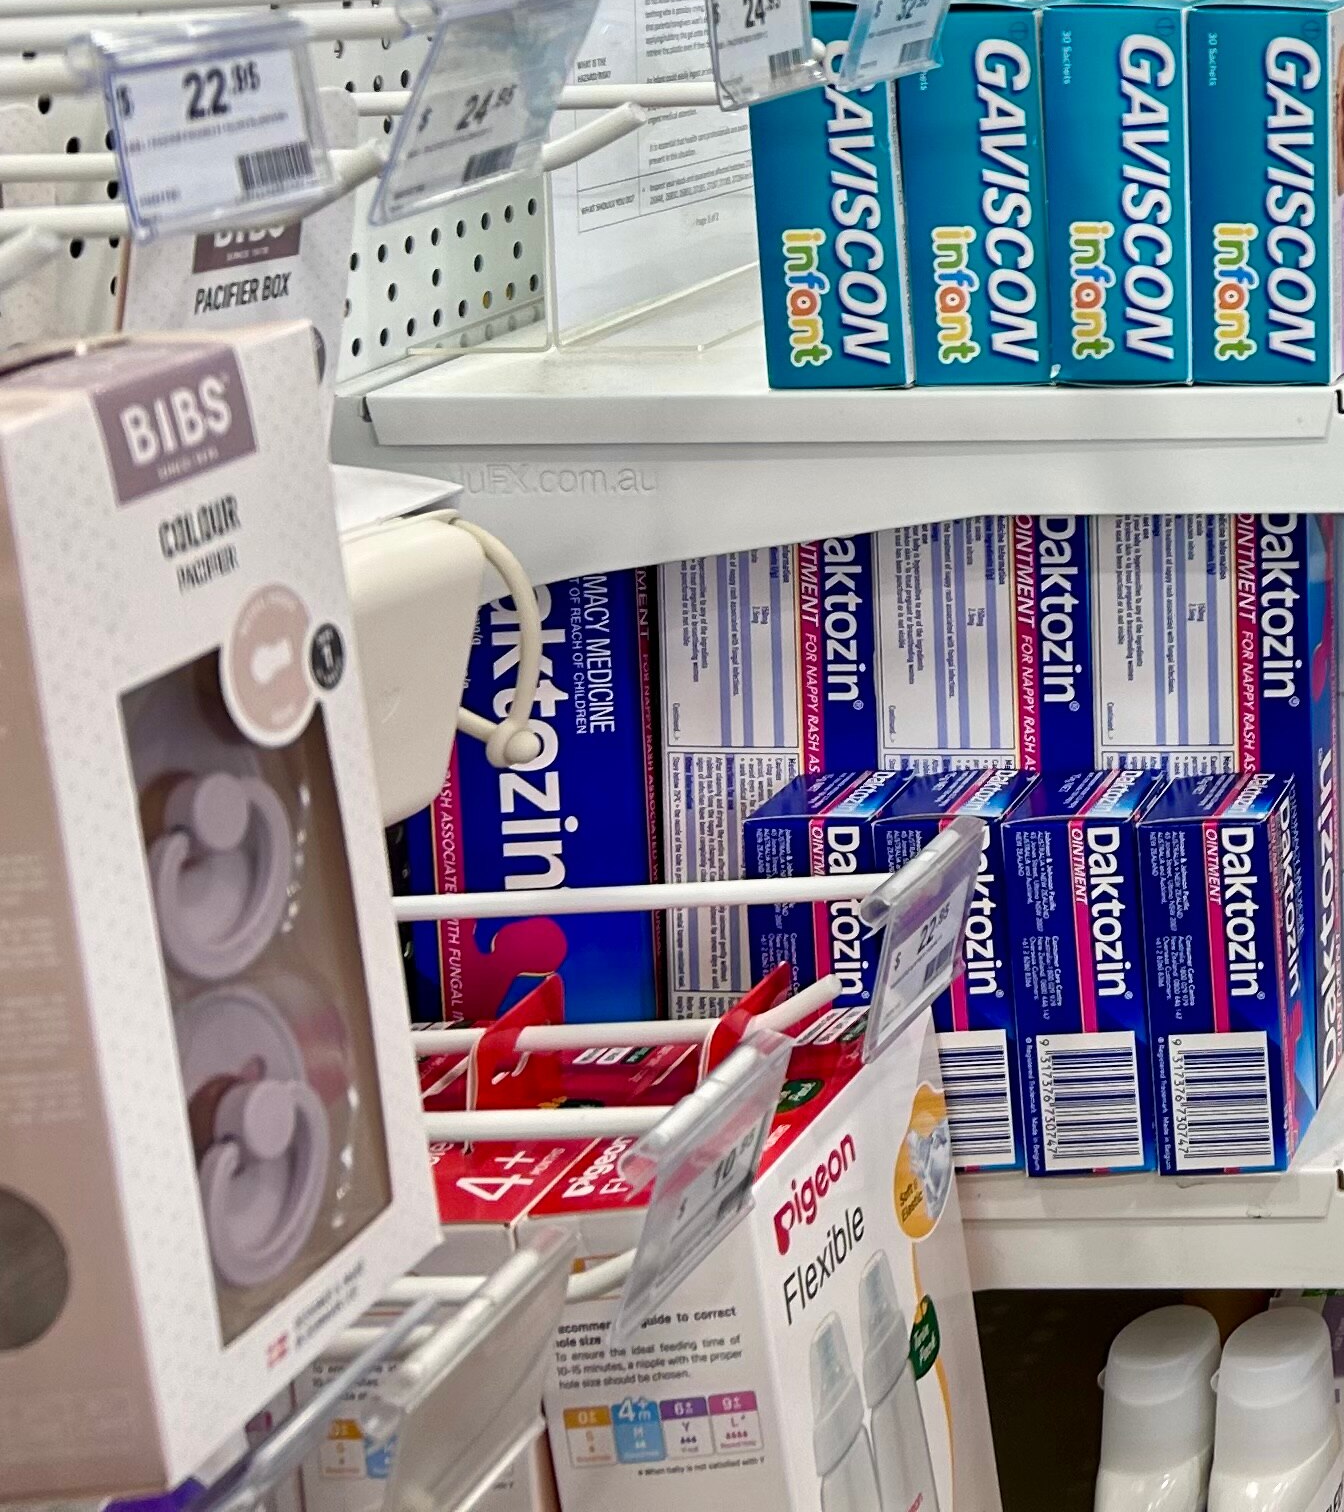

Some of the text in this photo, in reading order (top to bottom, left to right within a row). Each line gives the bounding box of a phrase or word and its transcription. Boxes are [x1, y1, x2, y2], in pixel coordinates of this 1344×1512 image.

[1061, 29, 1071, 45] 30
[1208, 31, 1217, 47] 30
[973, 37, 1041, 363] GAVISCON
[1119, 33, 1177, 361] GAVISCON
[1264, 36, 1322, 365] GAVISCON
[194, 271, 292, 315] PACIFIER BOX
[119, 374, 232, 467] BIBS
[158, 495, 241, 559] COLOUR
[569, 587, 587, 734] OF REACH OF CHILDREN
[583, 575, 616, 734] MACY MEDICINE
[823, 538, 867, 702] aktozin
[1015, 515, 1036, 754] OINTMENT FOR NAPPY RASH
[1039, 515, 1083, 704] Daktozin
[1237, 514, 1256, 751] OINTMENT FOR NAPPY RASH
[1260, 514, 1303, 699] Daktozin
[490, 584, 579, 890] aktozin
[805, 633, 820, 752] FOR NAPPY RASH
[827, 826, 869, 995] Datozin
[1071, 828, 1089, 905] OINTMENT
[1087, 826, 1132, 997] Daktozin
[1205, 828, 1222, 905] OINTMENT
[1221, 827, 1265, 997] Daktozin
[1280, 797, 1301, 998] Daktozin
[447, 947, 462, 1006] FUNGAL
[772, 1132, 857, 1256] pigeon
[781, 1205, 866, 1326] Flexible
[609, 1347, 627, 1357] the
[631, 1344, 655, 1355] ideal
[659, 1340, 697, 1354] feeding
[676, 1306, 737, 1322] to correct
[691, 1352, 708, 1363] the
